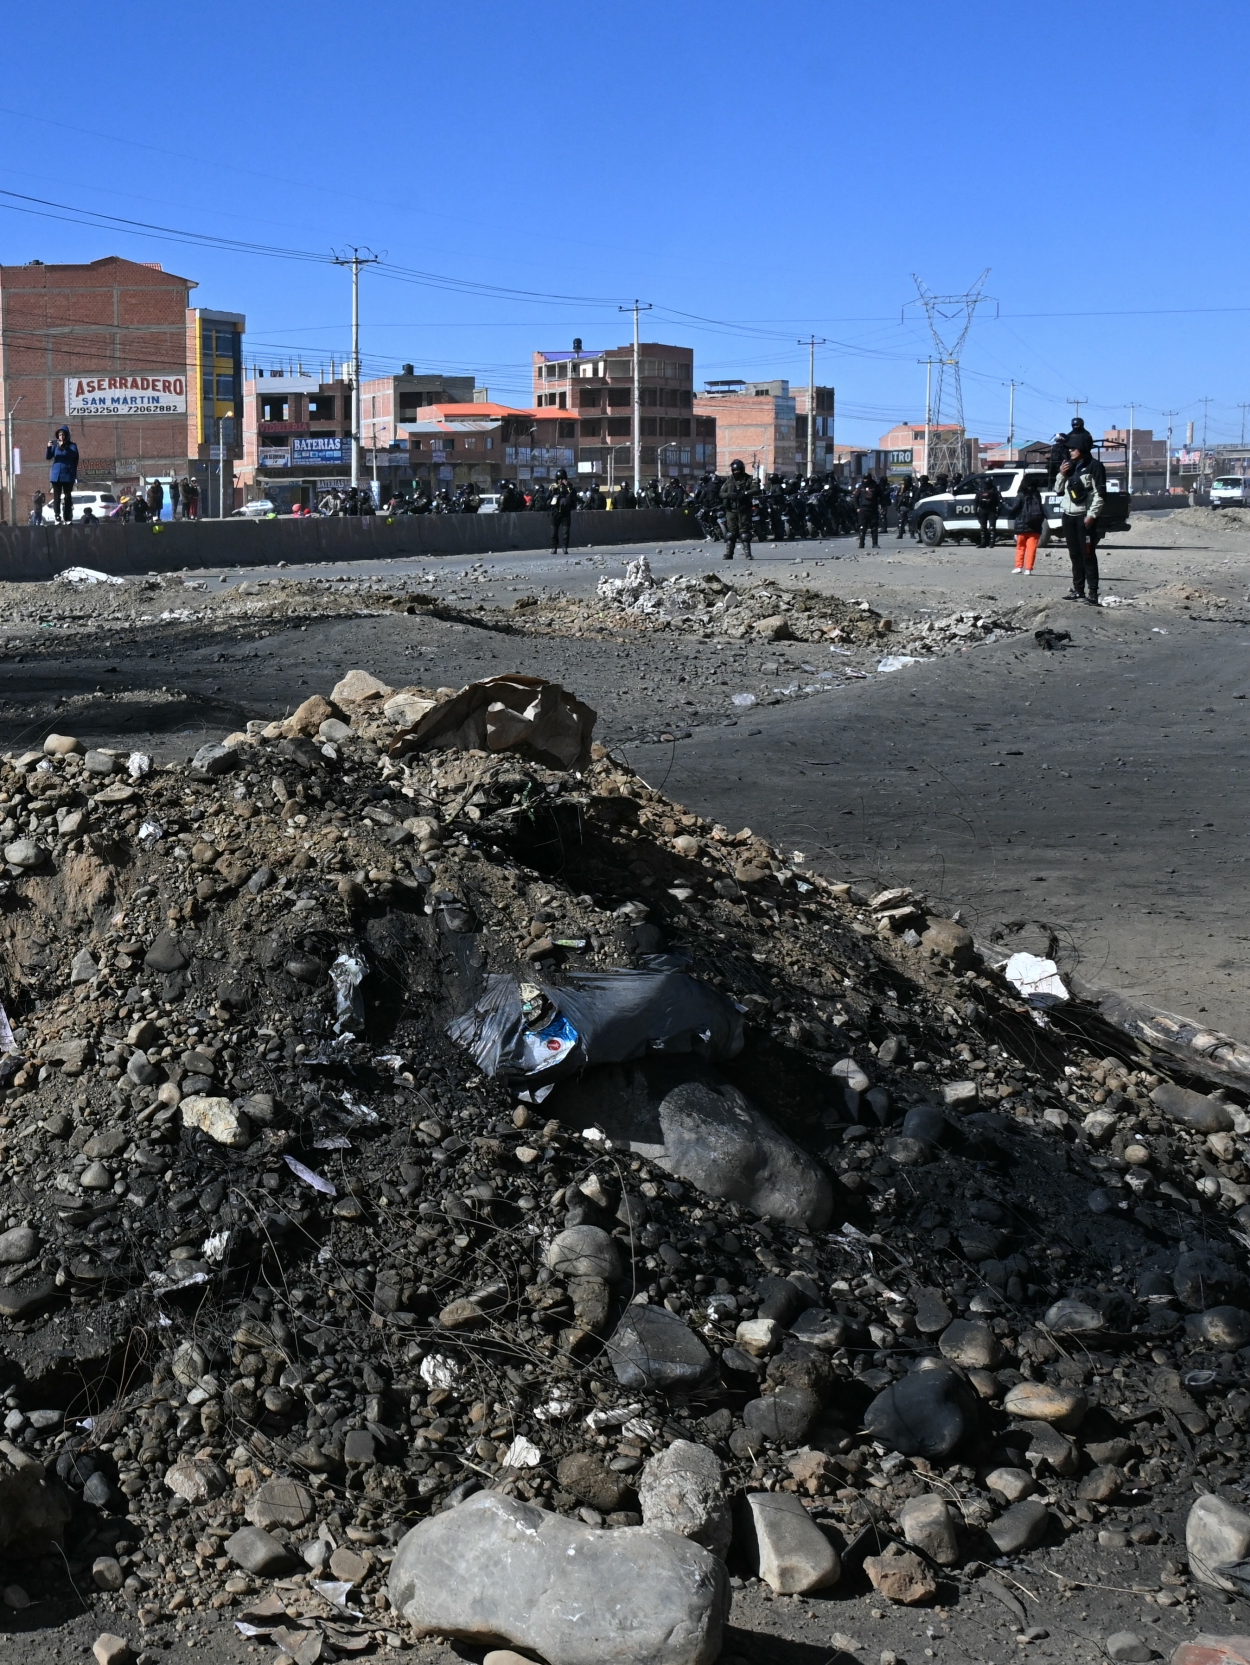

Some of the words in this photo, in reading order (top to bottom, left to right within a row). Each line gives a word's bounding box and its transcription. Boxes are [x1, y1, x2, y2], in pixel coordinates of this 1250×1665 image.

[75, 377, 184, 397] ASERRADERO
[82, 397, 107, 405] SAN
[111, 396, 160, 405] MARTIN
[70, 406, 119, 414] 71953250
[126, 405, 178, 413] 72062882
[294, 438, 341, 450] BATERIAS
